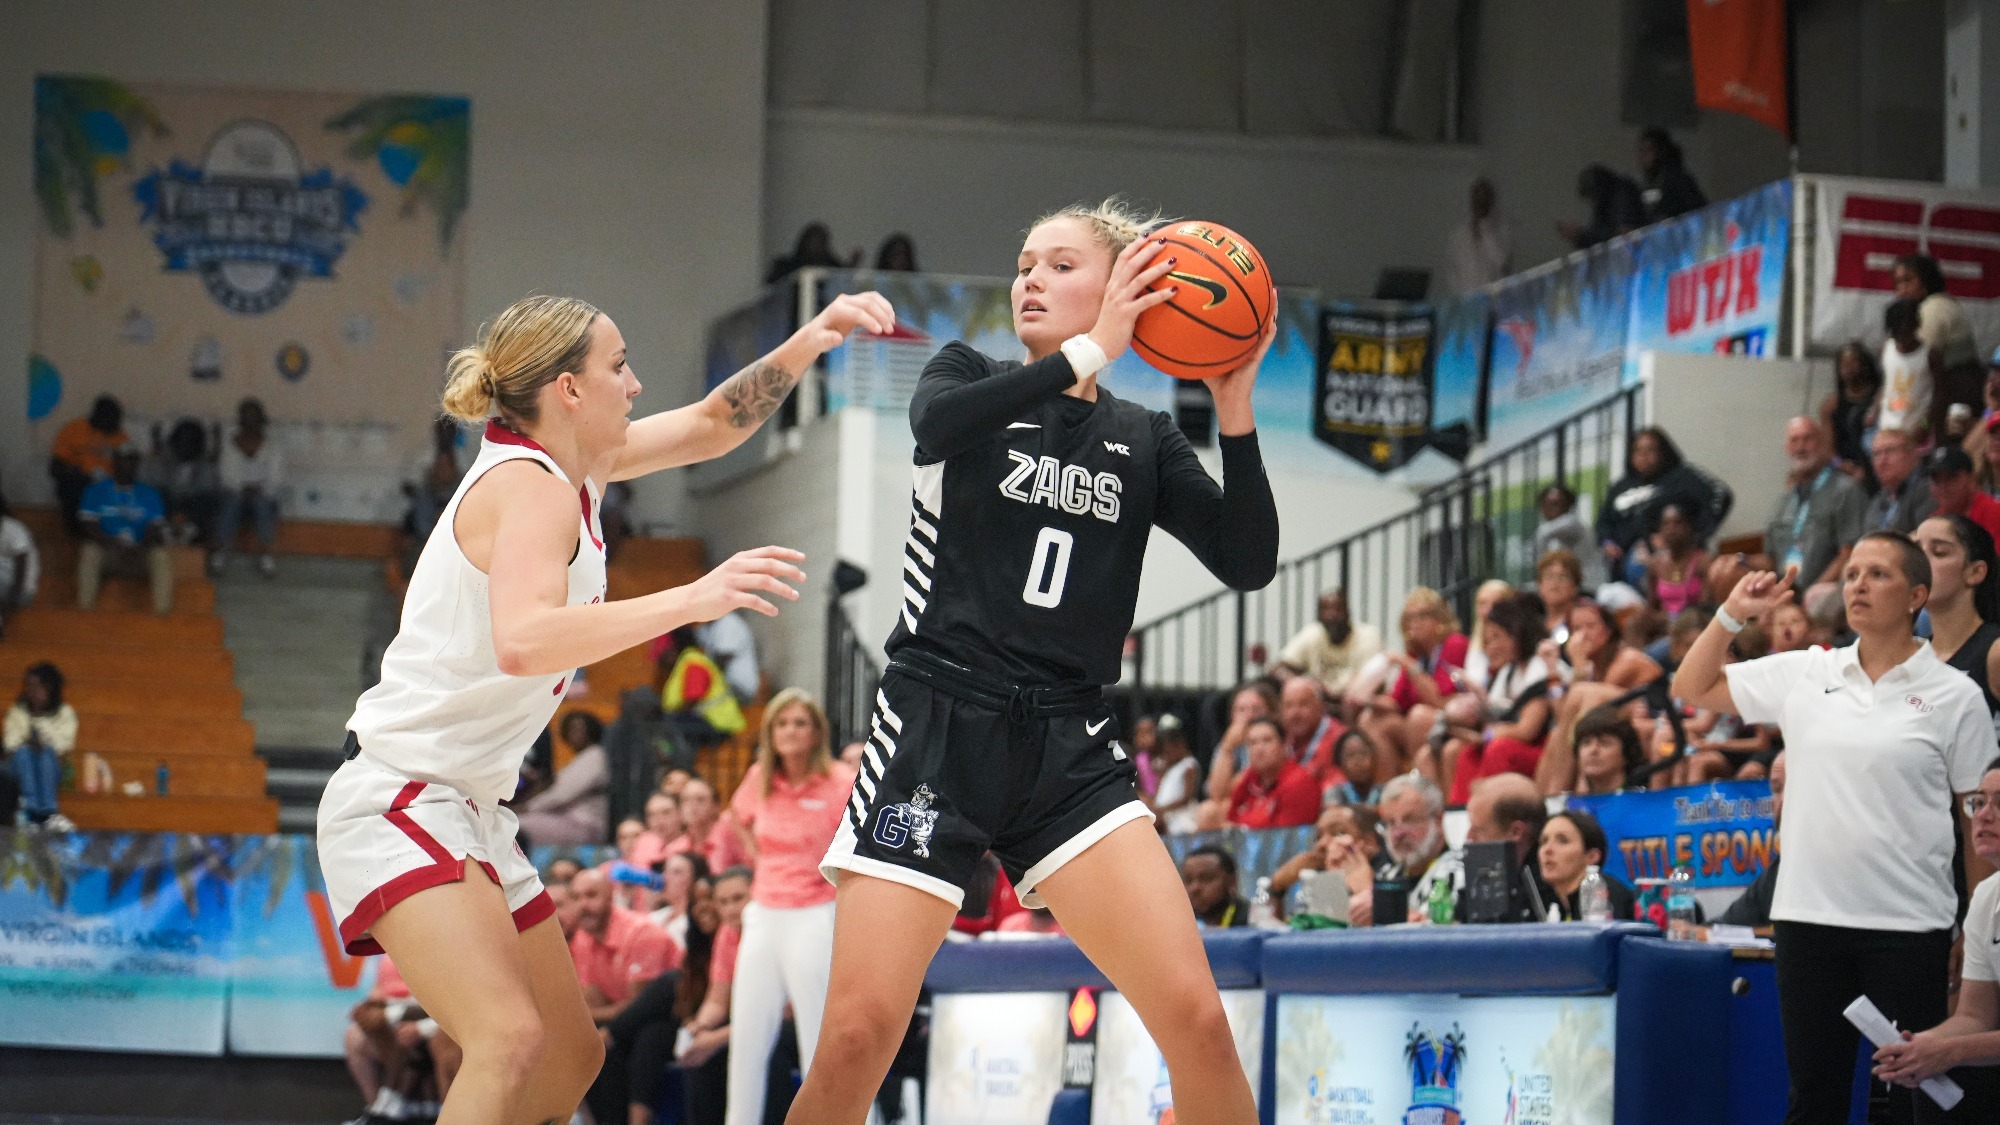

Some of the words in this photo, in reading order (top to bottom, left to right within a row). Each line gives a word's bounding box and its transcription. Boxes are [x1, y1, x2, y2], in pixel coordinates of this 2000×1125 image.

[1176, 223, 1256, 278] ELITE
[1330, 337, 1427, 376] ARMY
[1324, 390, 1429, 425] GUARD
[998, 448, 1123, 524] ZAGS
[1022, 526, 1074, 609] 0
[872, 804, 911, 849] G
[1619, 833, 1694, 881] TITLE
